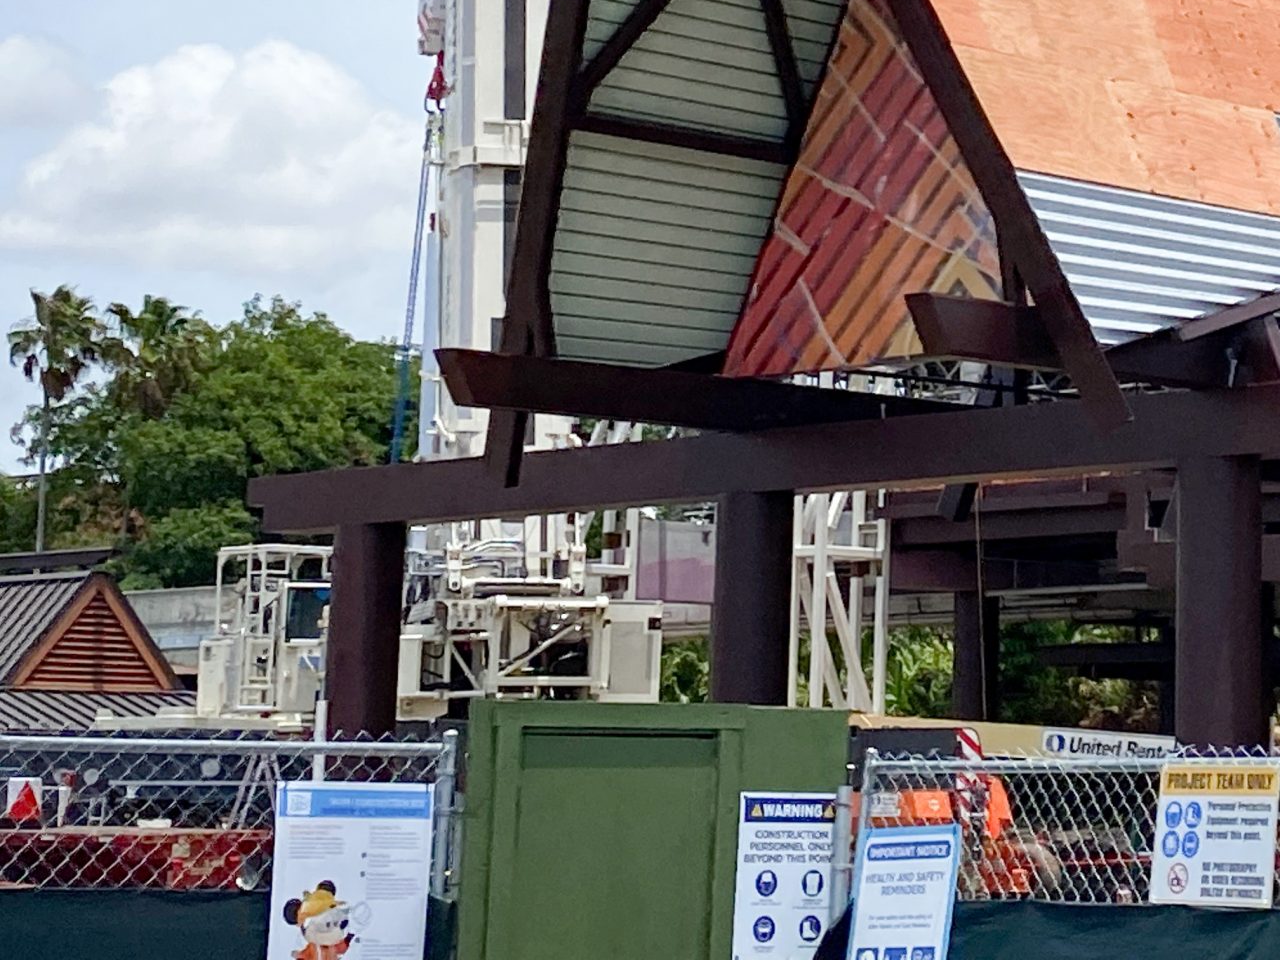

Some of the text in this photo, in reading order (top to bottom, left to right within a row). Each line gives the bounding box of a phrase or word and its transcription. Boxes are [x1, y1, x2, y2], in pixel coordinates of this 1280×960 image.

[1069, 736, 1167, 759] United Rent
[1167, 773, 1274, 790] PROJECT TEAM ONLY
[763, 803, 823, 817] WARNING
[755, 830, 830, 839] CONSTRUCTION
[749, 842, 834, 851] PERSONNEL ONLY
[916, 844, 948, 857] NOTICE
[744, 854, 783, 863] BEYOND
[786, 854, 806, 863] THIS
[865, 871, 945, 884] HEALTH AND SAFETY
[880, 884, 926, 896] REMINDERS
